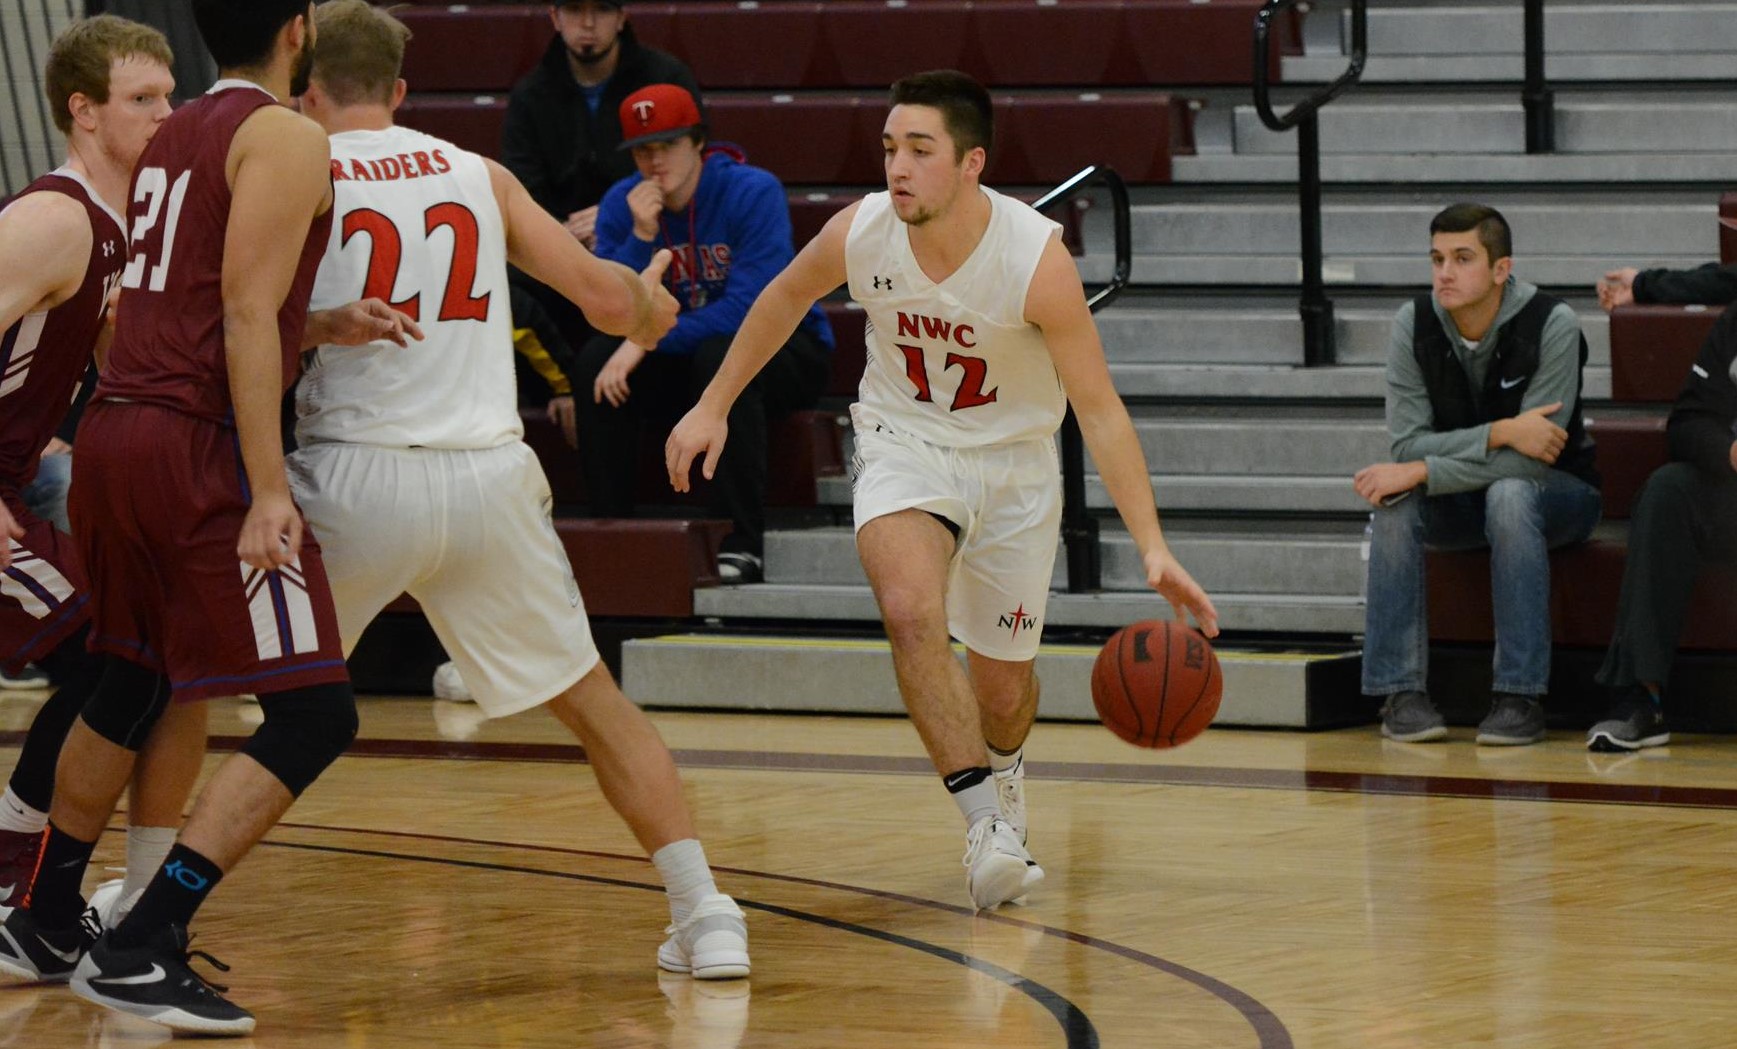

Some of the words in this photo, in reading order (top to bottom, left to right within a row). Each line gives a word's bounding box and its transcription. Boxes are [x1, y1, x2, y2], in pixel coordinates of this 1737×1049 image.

[330, 149, 451, 181] RAIDERS
[122, 167, 191, 291] 21
[342, 202, 491, 322] 22
[897, 312, 976, 348] NWC
[893, 343, 998, 412] 12
